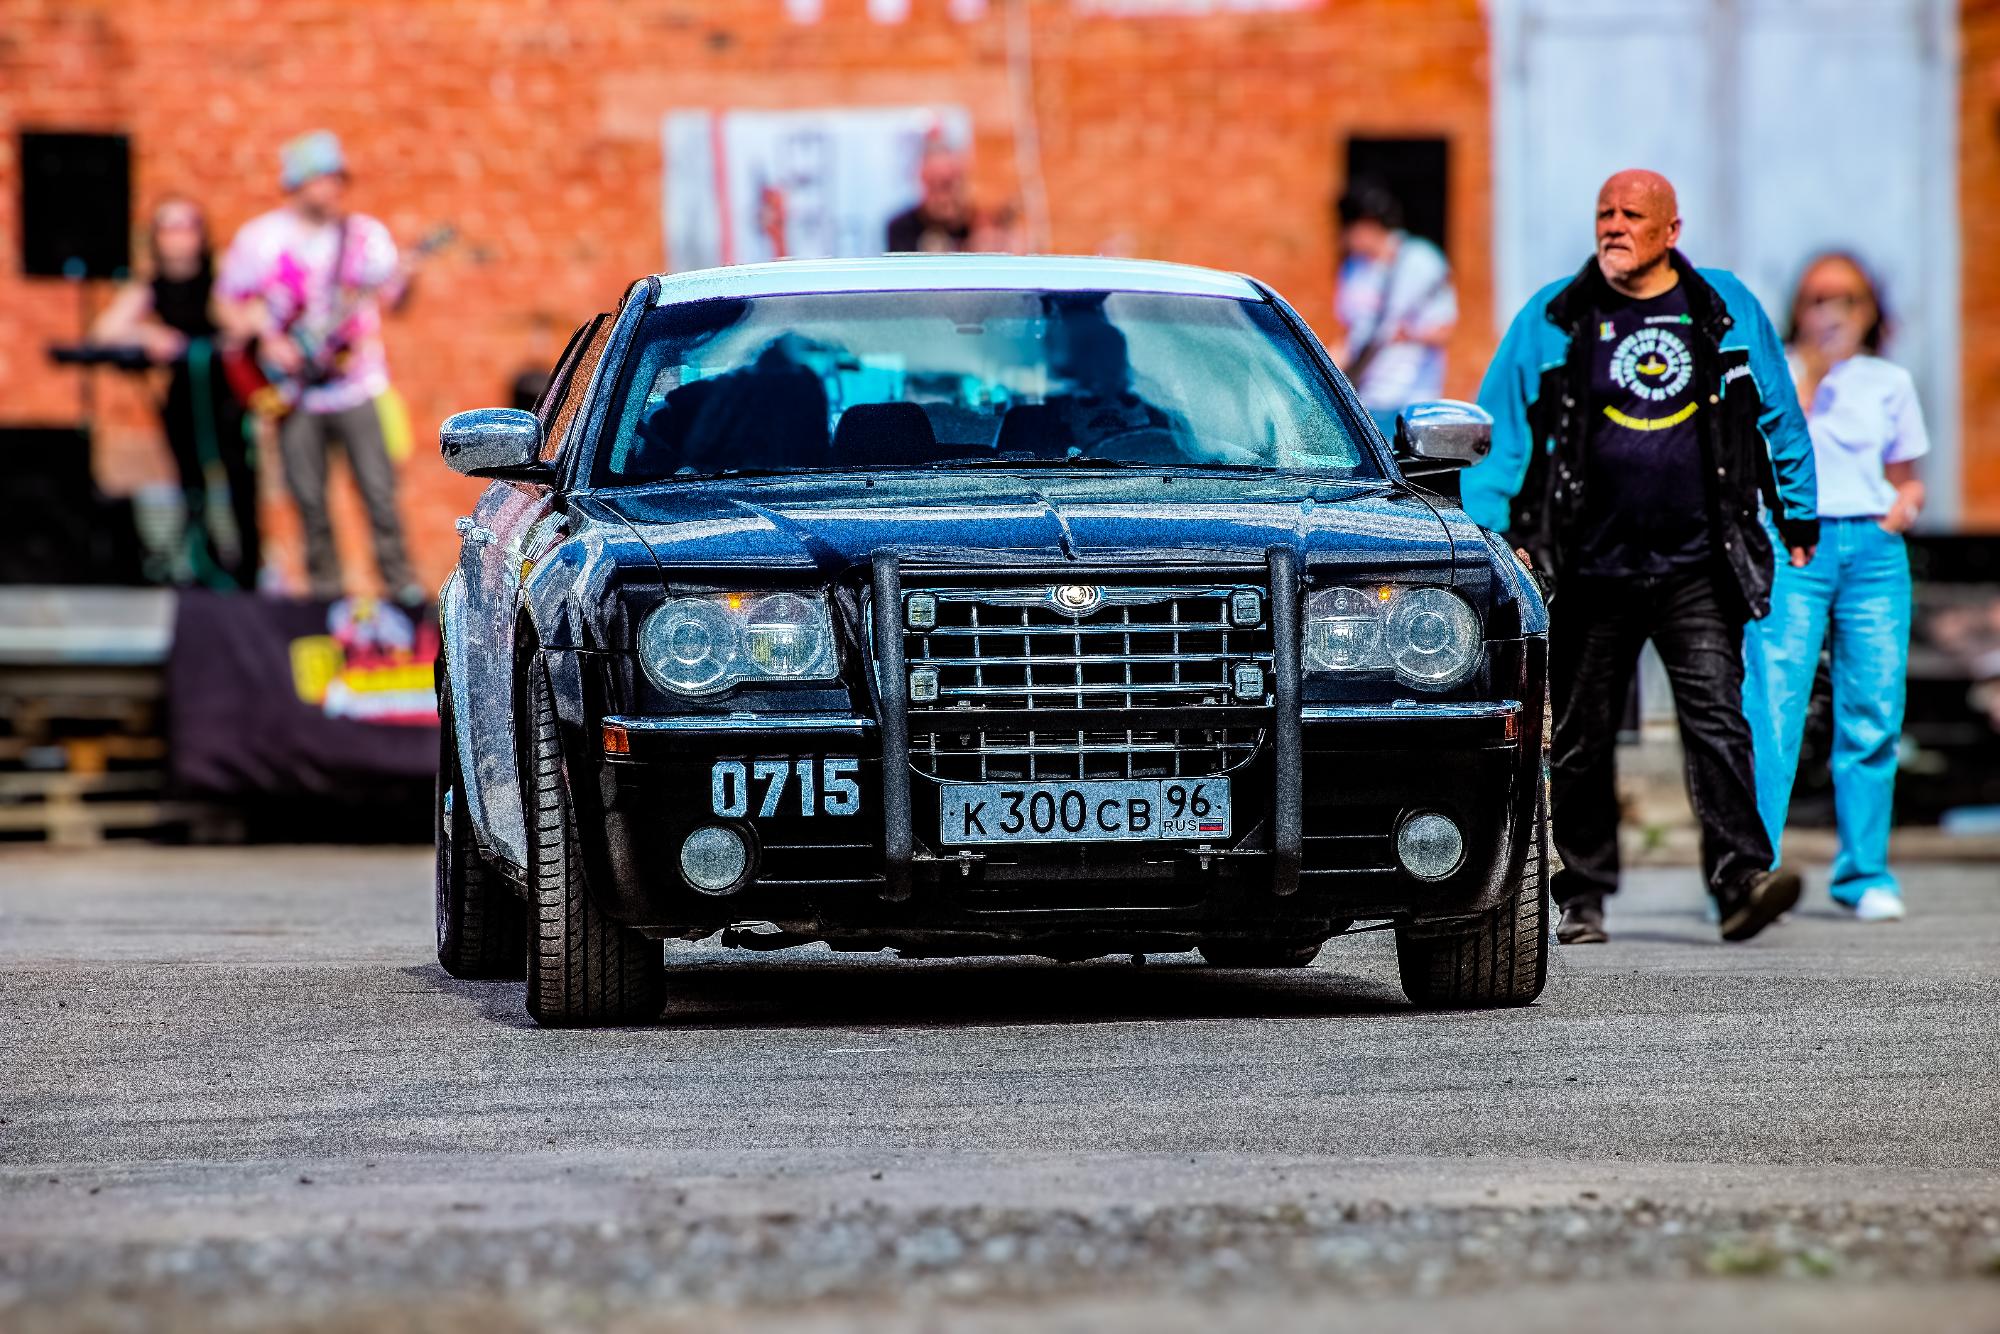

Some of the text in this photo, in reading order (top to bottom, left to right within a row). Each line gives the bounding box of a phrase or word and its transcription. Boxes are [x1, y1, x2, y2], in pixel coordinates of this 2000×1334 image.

[711, 758, 861, 818] 0715
[1166, 784, 1211, 818] 96
[1164, 819, 1197, 832] RUS
